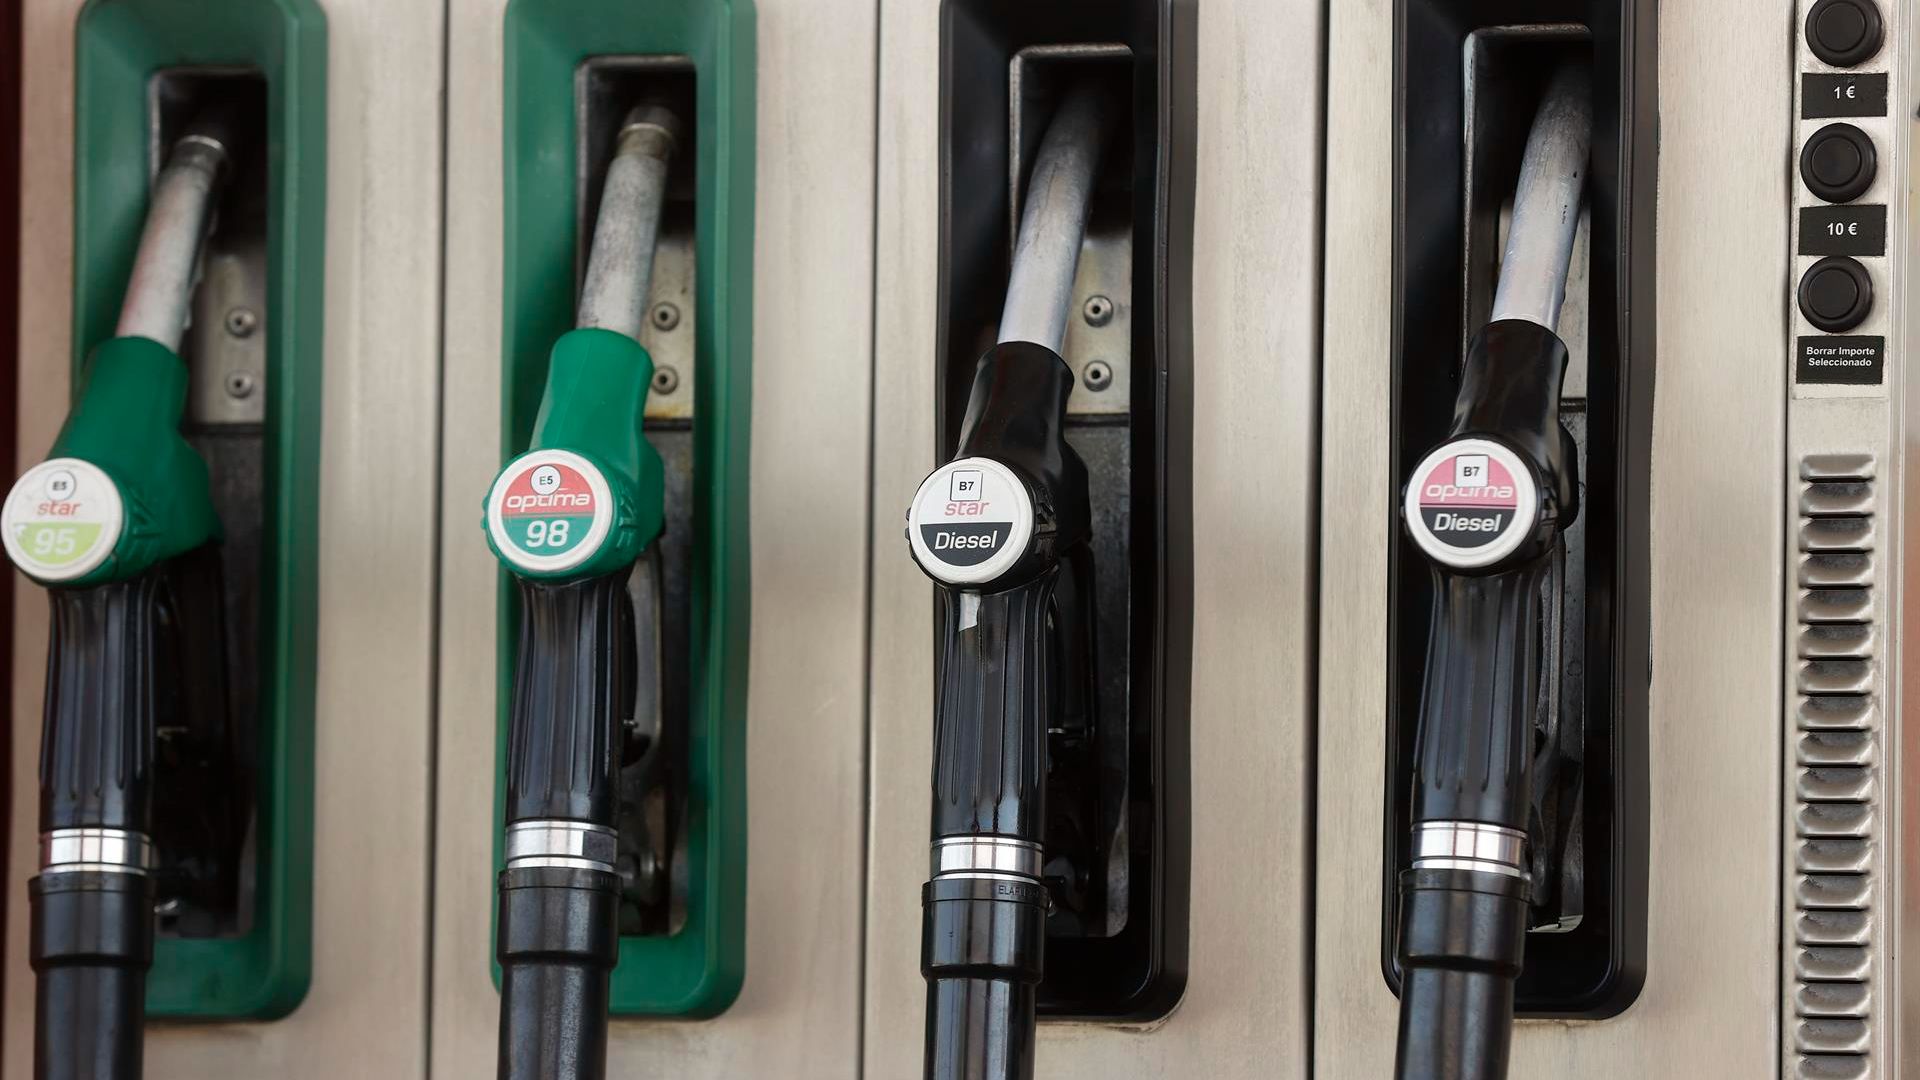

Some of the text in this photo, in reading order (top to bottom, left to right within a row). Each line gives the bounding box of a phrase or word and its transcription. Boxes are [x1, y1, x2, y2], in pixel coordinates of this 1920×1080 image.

[1833, 86, 1856, 99] 1 €
[1827, 222, 1858, 235] 10 €
[1806, 346, 1875, 357] Borrar Importe
[1808, 357, 1873, 367] Seleccionado
[1463, 466, 1480, 477] B7
[52, 480, 68, 491] E5
[539, 475, 554, 486] E5
[958, 481, 975, 491] B7
[37, 501, 81, 517] star
[944, 500, 990, 516] star
[1433, 512, 1502, 532] Diesel
[525, 519, 570, 548] 98
[934, 530, 998, 550] Diesel
[34, 527, 78, 555] 95
